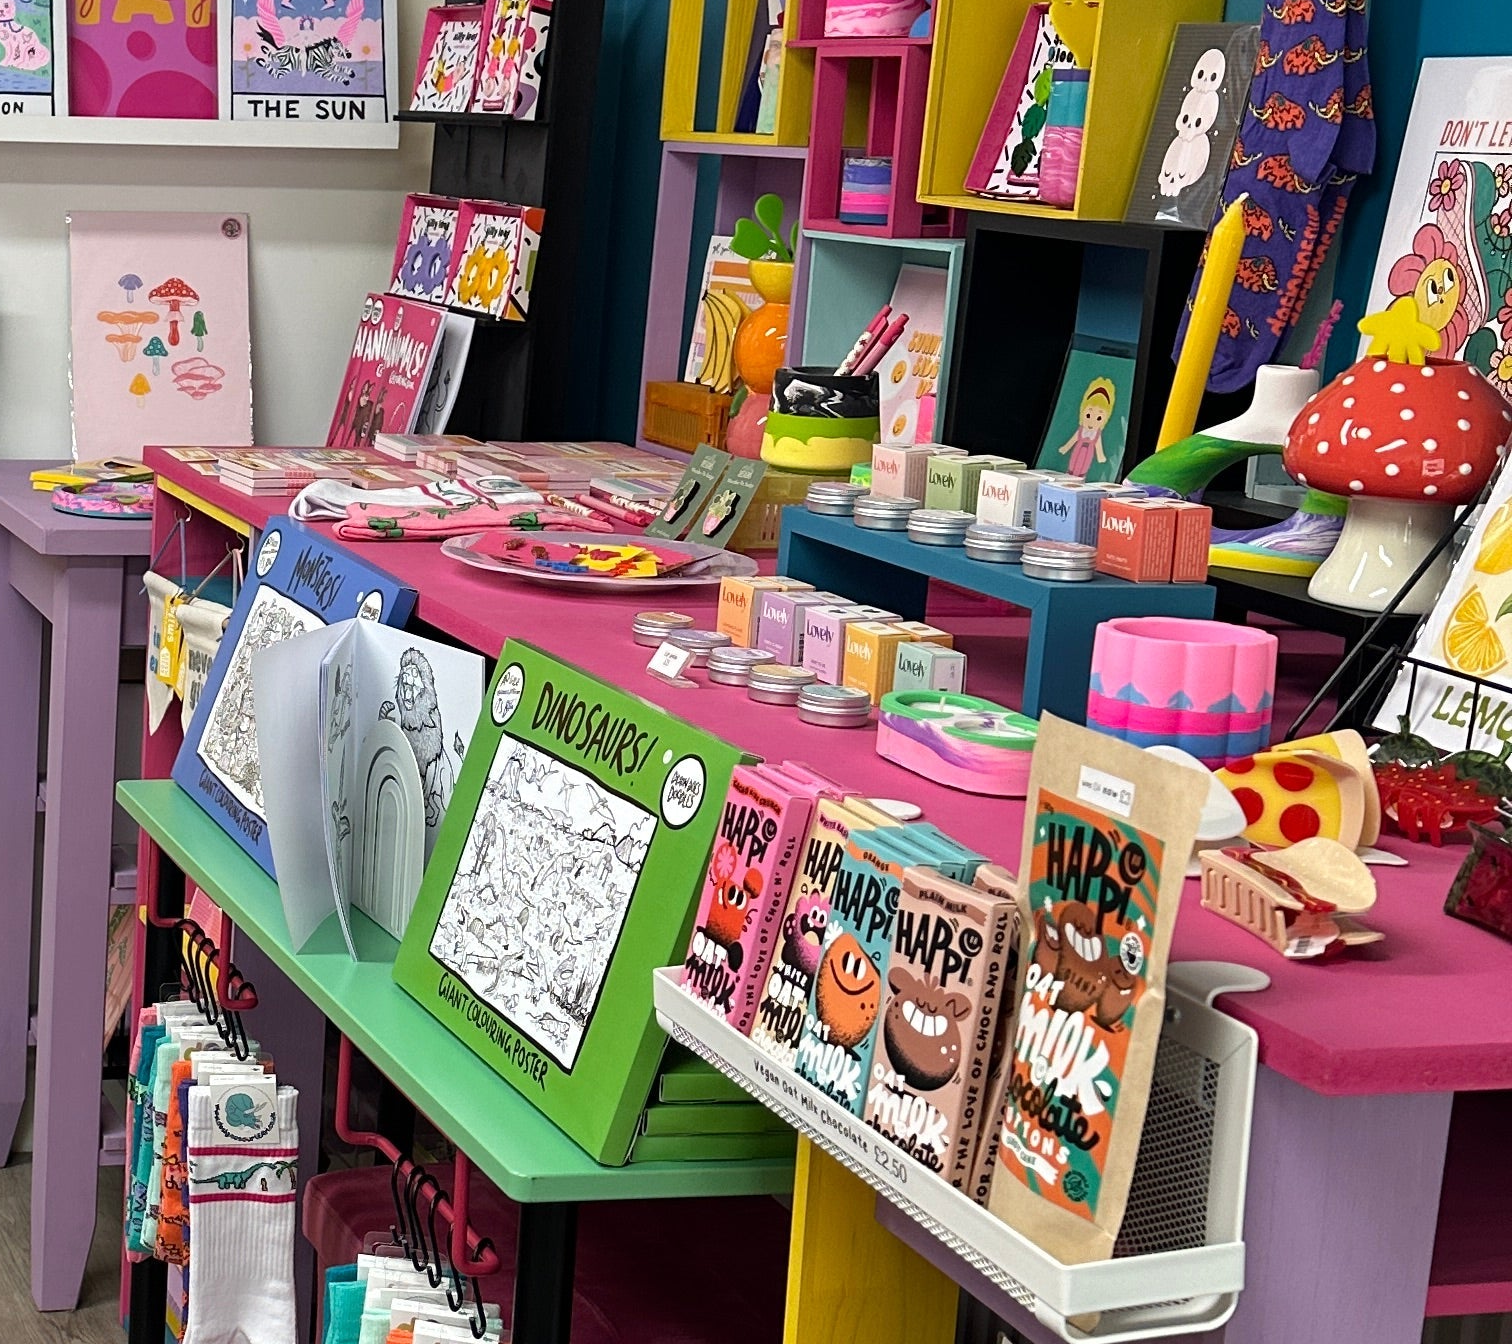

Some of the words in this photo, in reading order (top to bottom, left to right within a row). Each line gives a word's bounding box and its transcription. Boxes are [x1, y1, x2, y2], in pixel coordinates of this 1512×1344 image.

[248, 99, 300, 119] THE
[315, 100, 367, 120] SUN
[1439, 119, 1490, 147] DON'T
[873, 457, 901, 476] Lovely
[928, 468, 957, 492] Lovely
[981, 480, 1011, 504] Lovely
[1039, 493, 1070, 521] Lovely
[1101, 511, 1137, 540] Lovely
[286, 545, 345, 611] MONSTERS!
[721, 586, 749, 611] Lovely
[763, 601, 789, 625] Lovely
[807, 619, 835, 644] Lovely
[846, 634, 873, 660] Lovely
[898, 652, 926, 680] Lovely
[531, 681, 659, 787] DINOSAURS!
[1046, 822, 1132, 936] HAPPI
[918, 889, 945, 906] PLAIN
[944, 900, 968, 914] MILK
[745, 983, 757, 1008] THE
[752, 948, 764, 980] LOVE
[758, 927, 769, 945] OF
[764, 889, 782, 923] CHOC
[779, 836, 796, 867] ROLL
[992, 912, 1008, 955] ROLL
[691, 931, 727, 967] OAT
[895, 909, 973, 987] HAPPI
[768, 972, 806, 1009] OAT
[984, 961, 1000, 999] AND
[1025, 963, 1065, 1005] OAT
[439, 972, 469, 1013] GIANT
[466, 999, 512, 1059] COLOURING
[511, 1038, 548, 1092] POSTER
[804, 1013, 831, 1042] OAT
[976, 1006, 992, 1052] CHOC
[873, 1062, 906, 1092] OAT
[971, 1057, 984, 1079] OF
[754, 1059, 780, 1085] Vegan
[782, 1079, 798, 1099] Oat
[800, 1093, 818, 1114] Milk
[820, 1108, 869, 1154] Chocolate
[873, 1144, 908, 1184] £2.50
[962, 1085, 979, 1130] LOVE
[955, 1136, 970, 1170] THE
